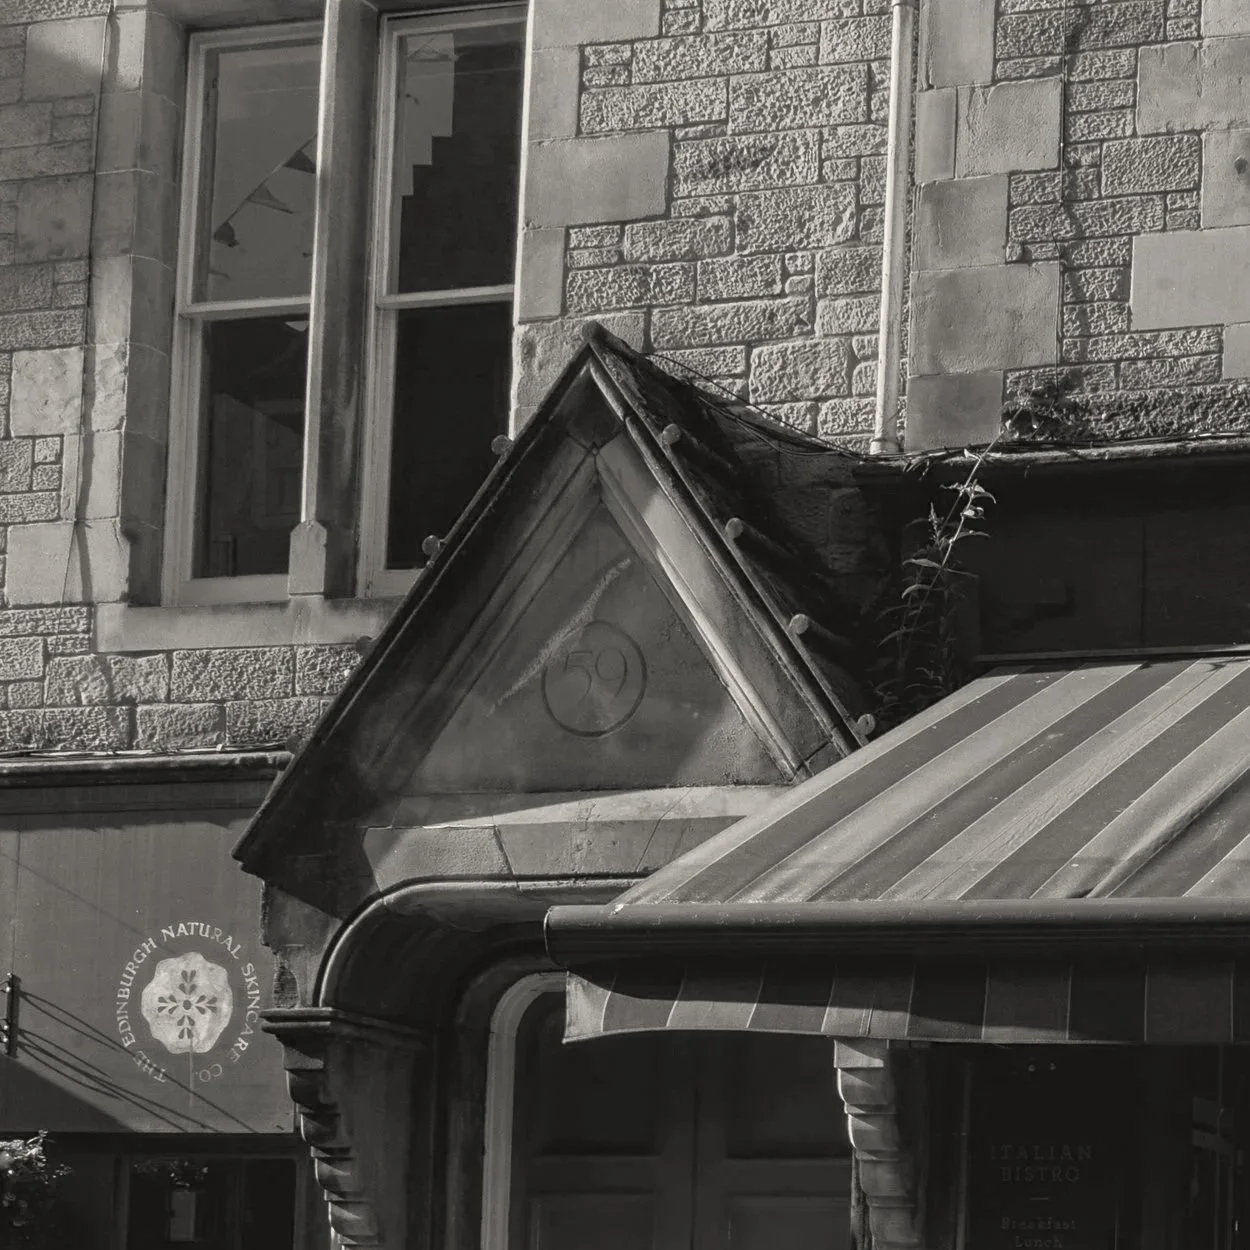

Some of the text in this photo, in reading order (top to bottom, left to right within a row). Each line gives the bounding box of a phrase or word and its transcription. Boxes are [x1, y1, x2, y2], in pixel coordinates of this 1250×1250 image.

[563, 647, 628, 700] 59
[116, 937, 158, 1048] EDINBURGH
[161, 922, 241, 960] NATURAL
[227, 962, 260, 1063] SKINCARE
[988, 1145, 1094, 1160] ITALIAN
[1000, 1166, 1082, 1183] BISTRO
[1014, 1235, 1064, 1249] Lunch
